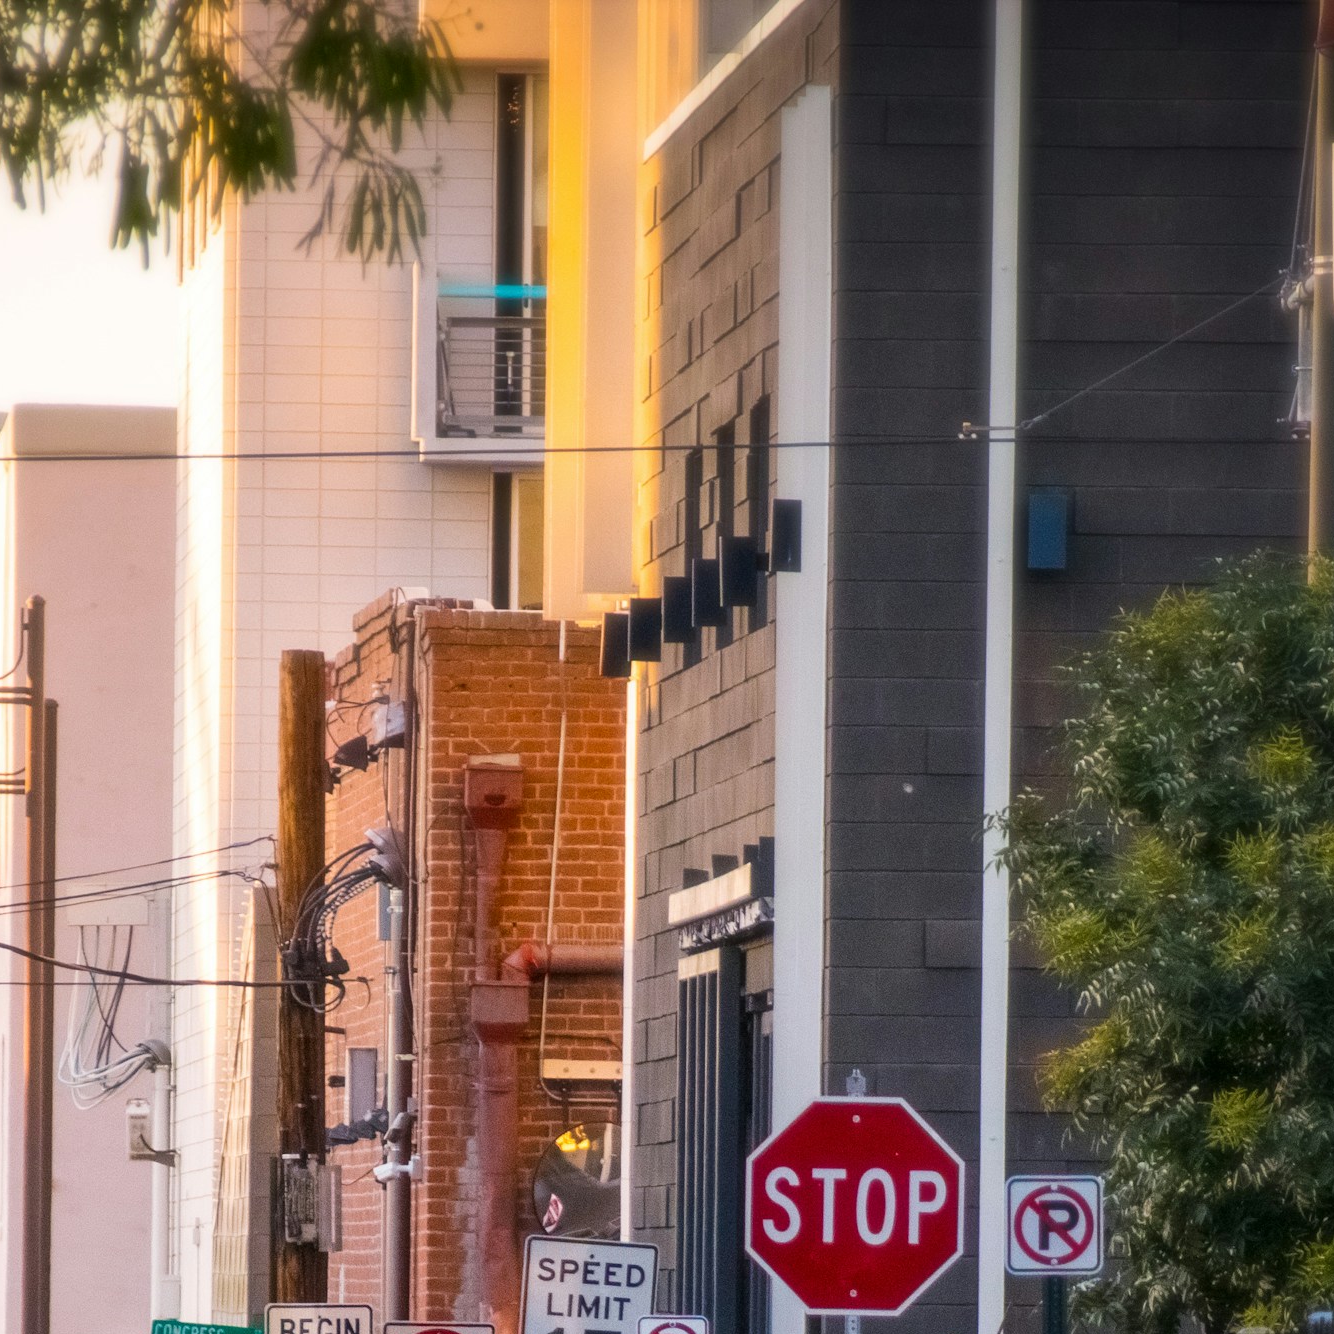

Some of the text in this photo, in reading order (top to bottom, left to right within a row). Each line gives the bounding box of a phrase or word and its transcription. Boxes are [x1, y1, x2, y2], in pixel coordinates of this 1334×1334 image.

[762, 1166, 948, 1246] STOP
[537, 1257, 646, 1288] SPEED
[546, 1292, 631, 1321] LIMIT
